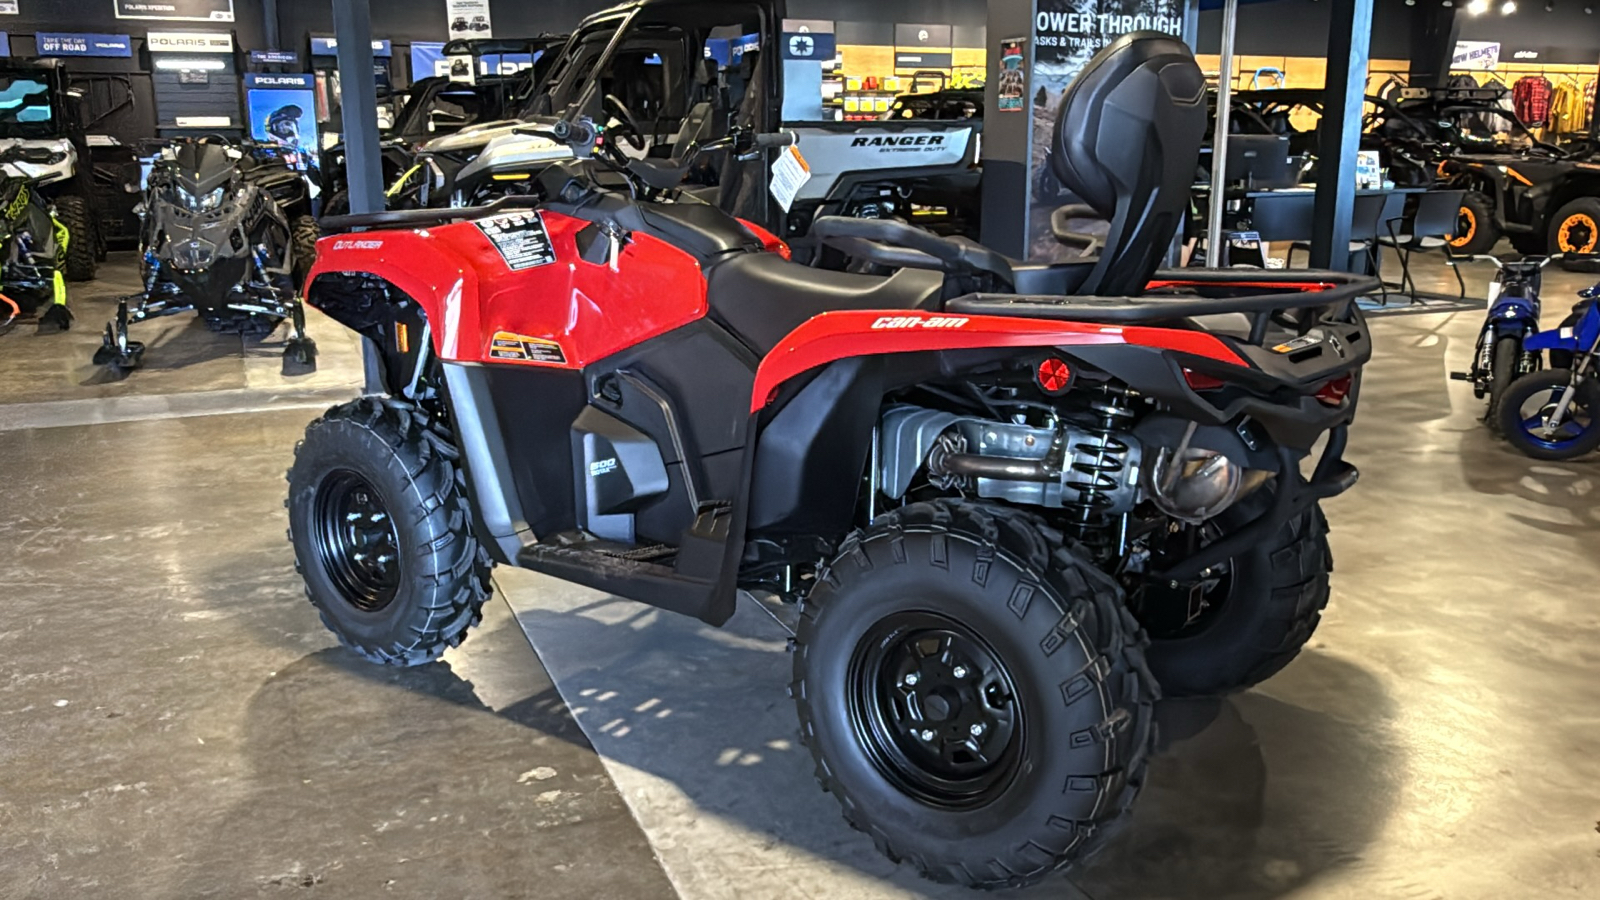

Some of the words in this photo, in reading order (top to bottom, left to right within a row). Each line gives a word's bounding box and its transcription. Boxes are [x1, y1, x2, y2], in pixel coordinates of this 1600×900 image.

[1037, 12, 1092, 33] OWER
[1097, 15, 1182, 36] THROUGH
[150, 38, 206, 46] POLARIS
[1035, 36, 1058, 46] ASKS
[1060, 37, 1067, 46] &
[1070, 37, 1101, 47] TRAILS
[43, 43, 60, 51] OFF
[62, 44, 87, 52] ROAD
[255, 76, 306, 85] POLARIS
[851, 136, 945, 147] RANGER
[333, 240, 384, 250] OUTLANDER
[871, 316, 970, 329] can-am
[590, 458, 616, 471] 500
